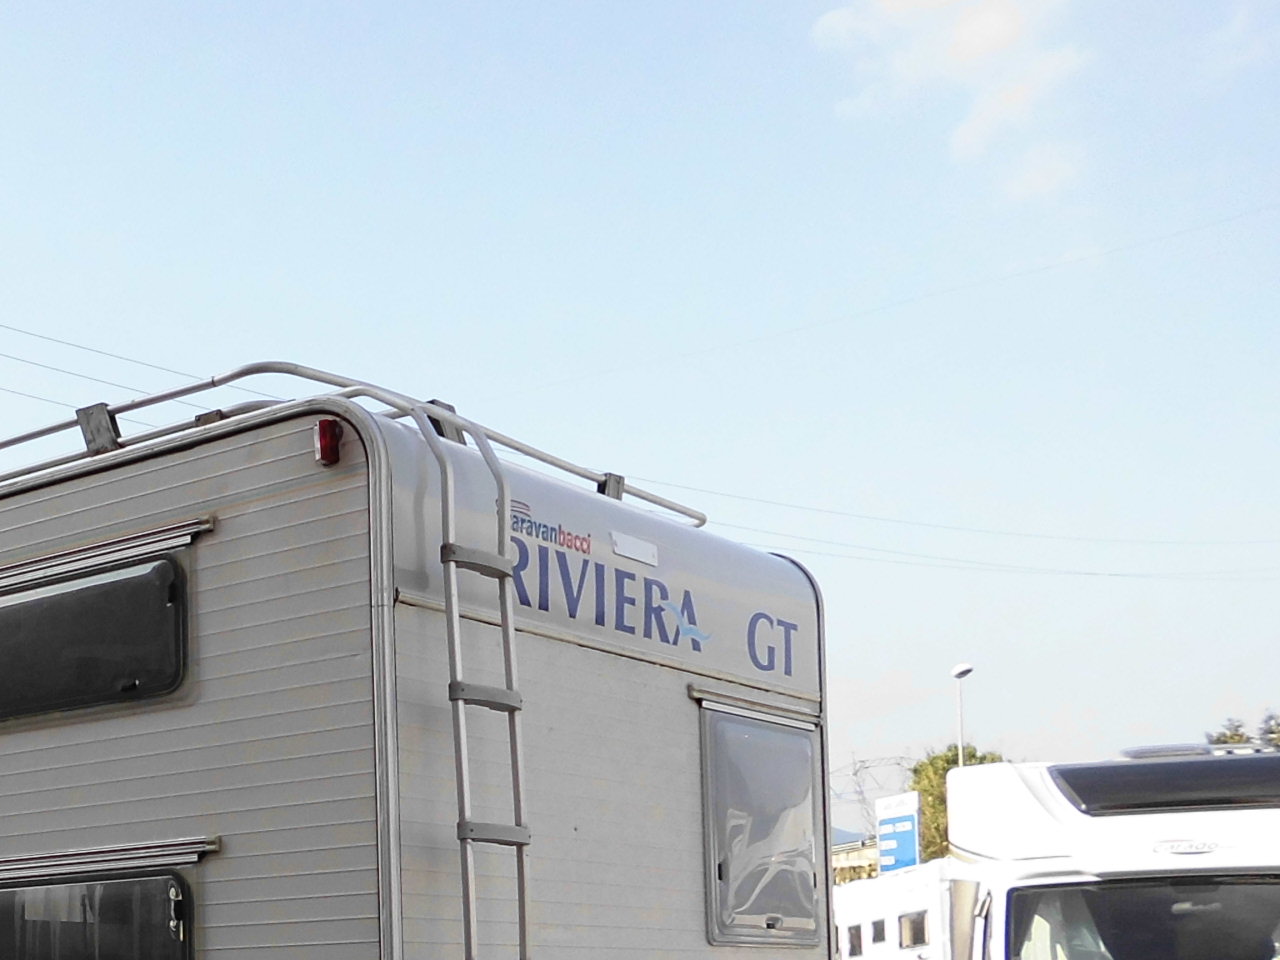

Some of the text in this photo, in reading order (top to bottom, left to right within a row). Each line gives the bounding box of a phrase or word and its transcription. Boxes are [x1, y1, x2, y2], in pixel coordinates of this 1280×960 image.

[510, 514, 591, 554] aravanbacci
[510, 538, 798, 676] RIVIERA GT
